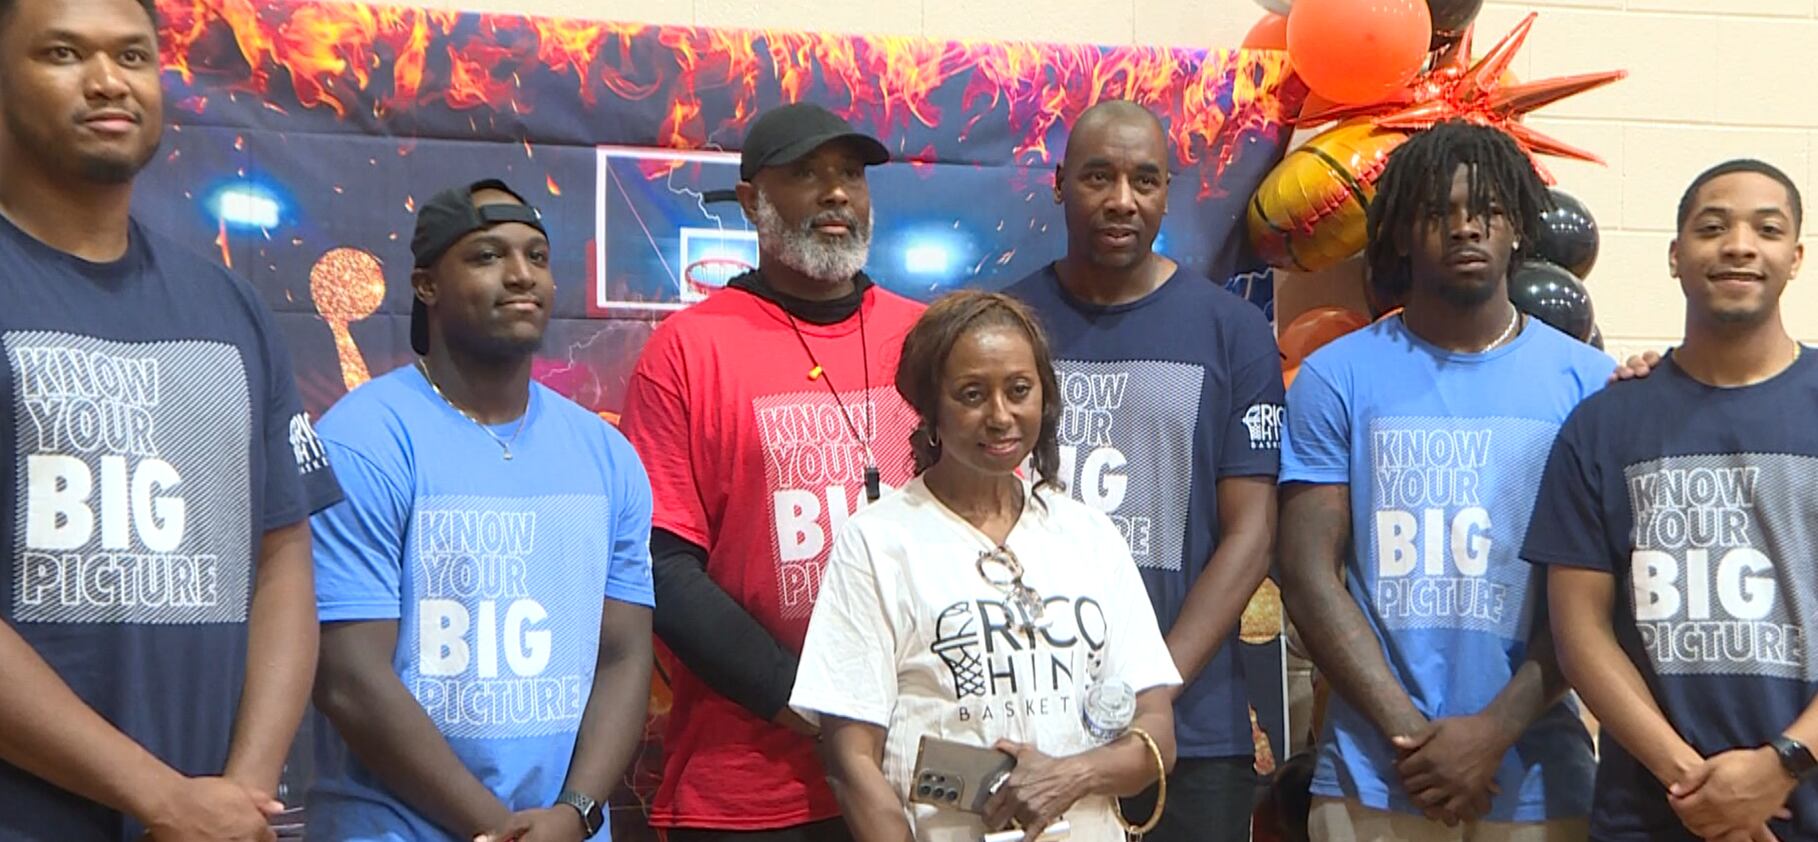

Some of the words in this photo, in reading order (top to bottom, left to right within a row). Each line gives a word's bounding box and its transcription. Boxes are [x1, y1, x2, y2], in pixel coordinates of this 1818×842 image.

[16, 347, 158, 405] KNOW
[1055, 371, 1128, 409] OW
[26, 398, 158, 456] YOUR
[760, 401, 876, 447] KNOW
[1057, 406, 1113, 446] UR
[1261, 404, 1284, 427] RIC
[1374, 429, 1492, 469] KNOW
[26, 454, 184, 550] BIG
[1057, 446, 1128, 513] IG
[1378, 467, 1481, 507] YOUR
[1632, 467, 1760, 512] KNOW
[418, 511, 536, 553] KNOW
[1376, 507, 1492, 577] BIG
[1634, 508, 1751, 549] YOUR
[22, 552, 217, 606] PICTURE
[420, 555, 529, 598] YOUR
[1631, 549, 1776, 621] BIG
[1377, 577, 1506, 623] PICTURE
[419, 599, 552, 678] BIG
[976, 595, 1107, 653] RICO
[416, 677, 581, 725] PICTURE
[959, 696, 1070, 722] BASKET
